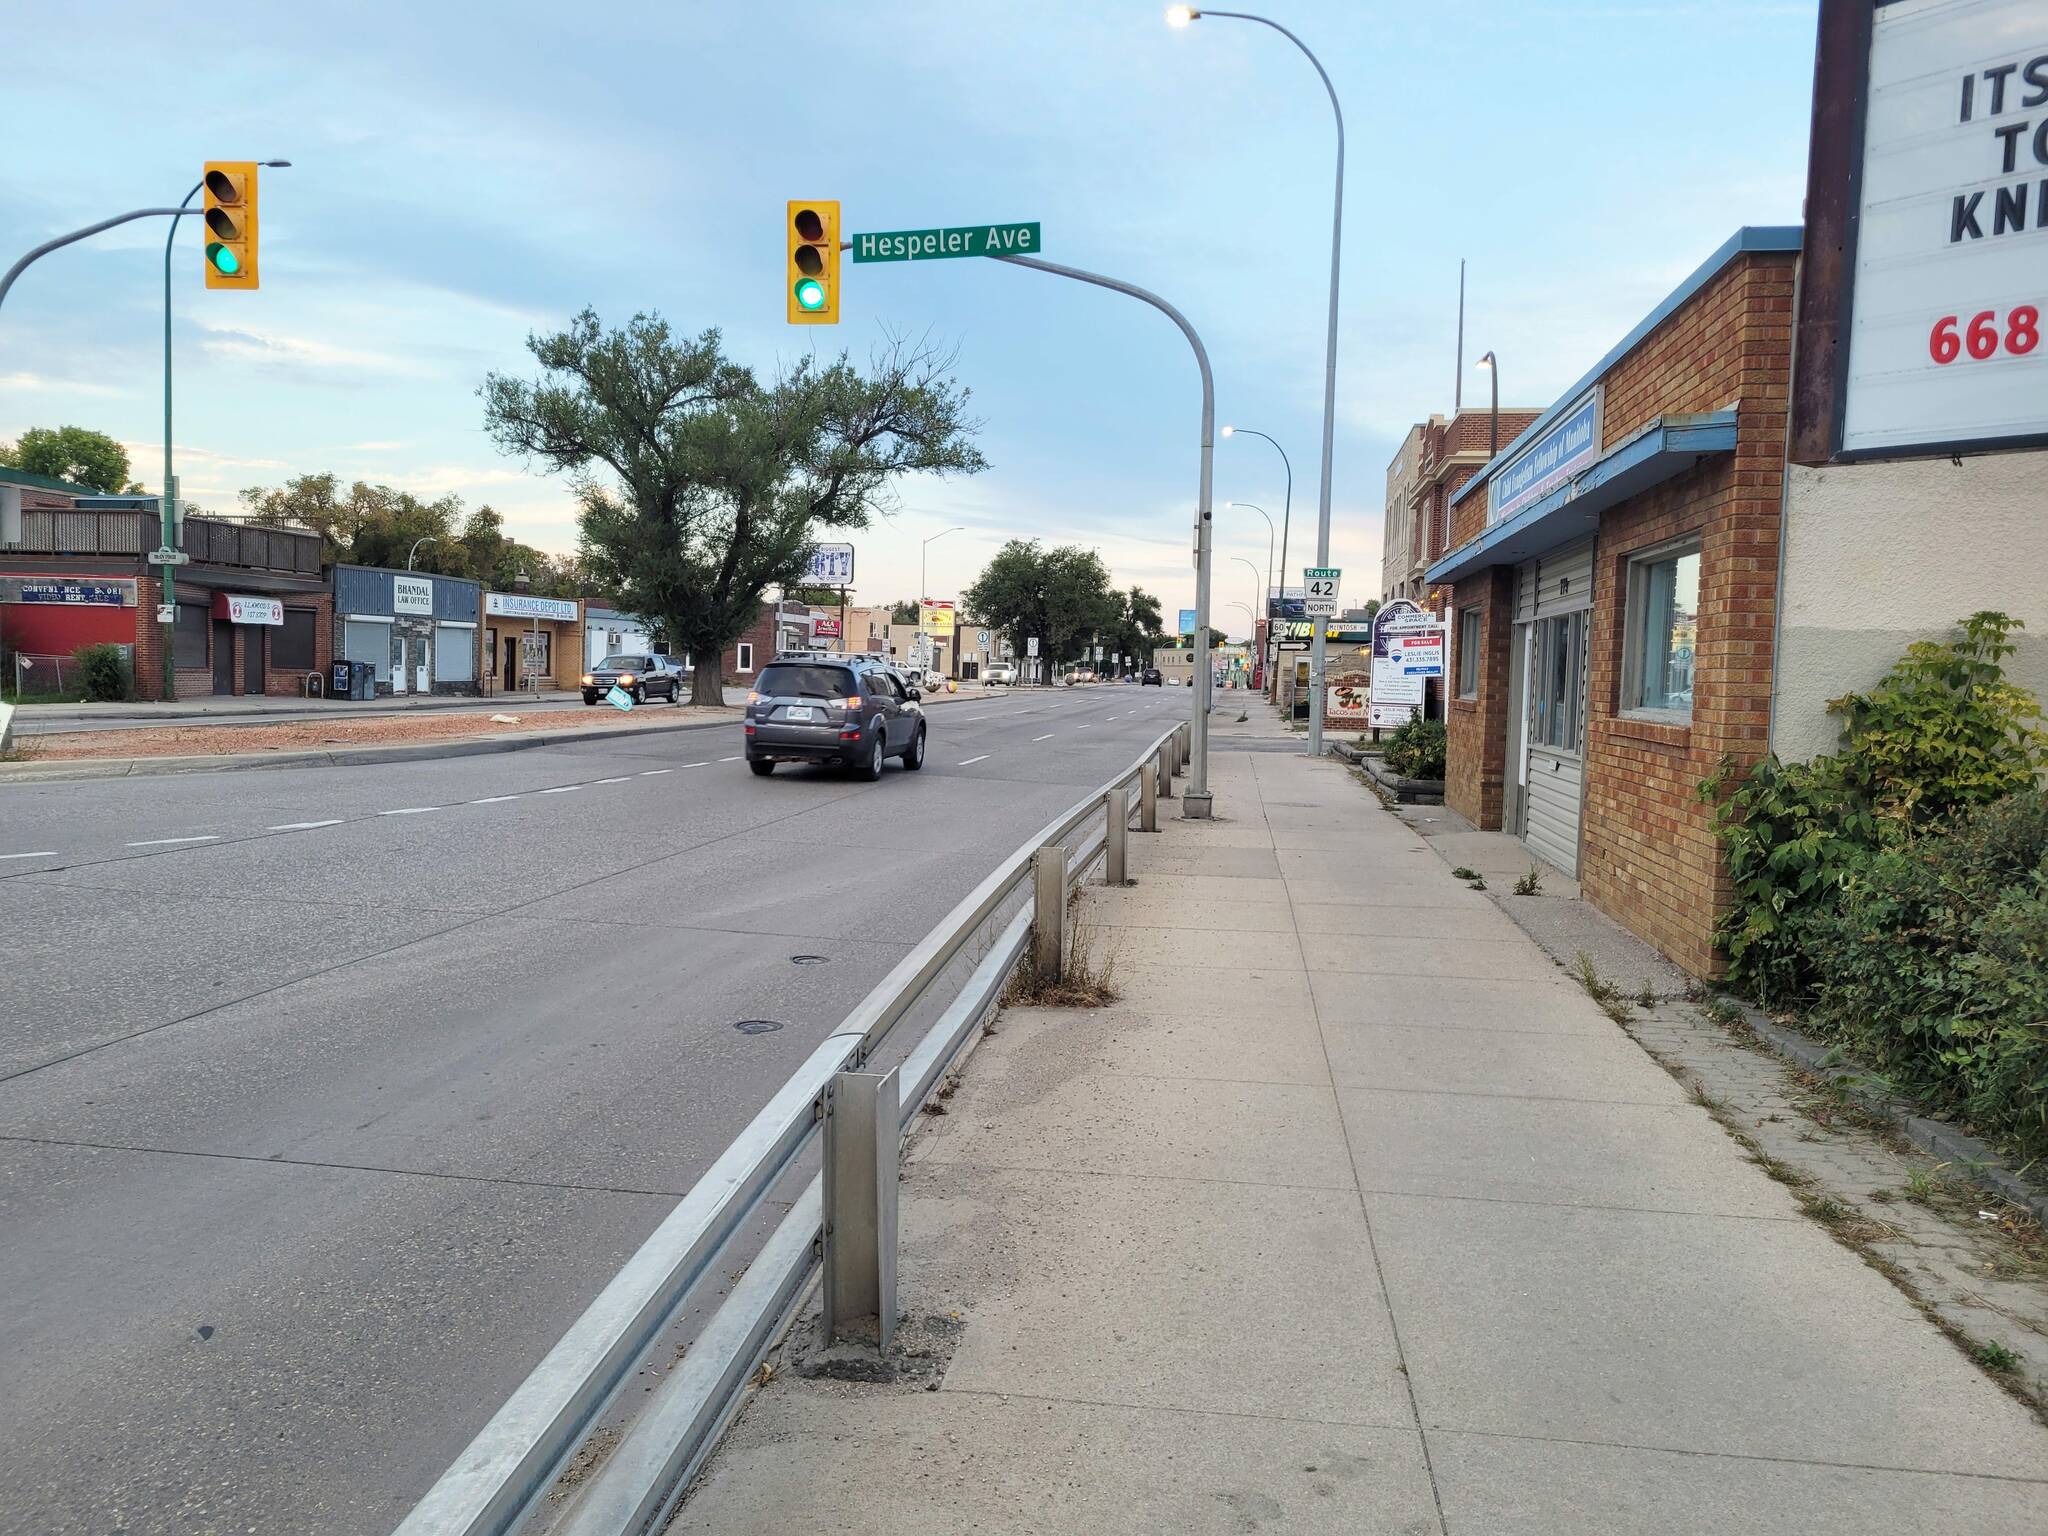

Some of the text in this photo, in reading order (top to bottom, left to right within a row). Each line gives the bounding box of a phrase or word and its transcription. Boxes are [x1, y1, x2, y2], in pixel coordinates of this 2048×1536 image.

[1960, 55, 2048, 123] ITS
[861, 227, 1031, 260] Hespeler Ave
[1929, 305, 2040, 365] 668
[1307, 569, 1338, 577] Route
[397, 584, 430, 597] BHANDAL
[1310, 581, 1333, 596] 42
[397, 595, 430, 606] LAW OFFICE
[502, 597, 540, 612] INSURANCE
[540, 600, 560, 613] DEPOT
[1307, 604, 1335, 612] NORTH
[1274, 623, 1284, 631] 60
